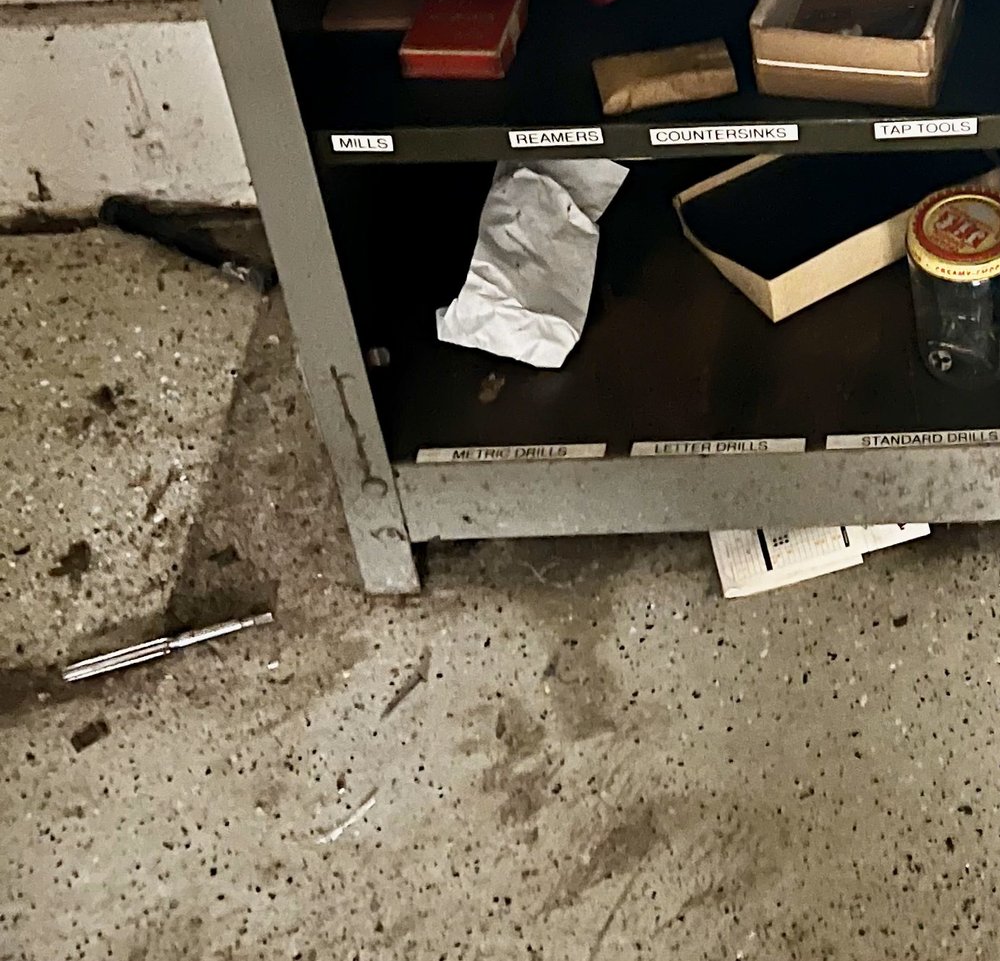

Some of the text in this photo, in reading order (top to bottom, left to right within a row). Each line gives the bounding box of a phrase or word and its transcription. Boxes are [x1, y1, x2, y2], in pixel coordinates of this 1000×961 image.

[656, 127, 787, 143] COUNTERSINKS
[881, 121, 971, 136] TAP TOOLS
[339, 137, 389, 150] MILLS
[516, 130, 600, 146] REAMERS
[861, 429, 999, 447] STANDARD DRILLS
[452, 445, 568, 461] METRIC DRILLS
[654, 439, 769, 454] LETTER DRILLS
